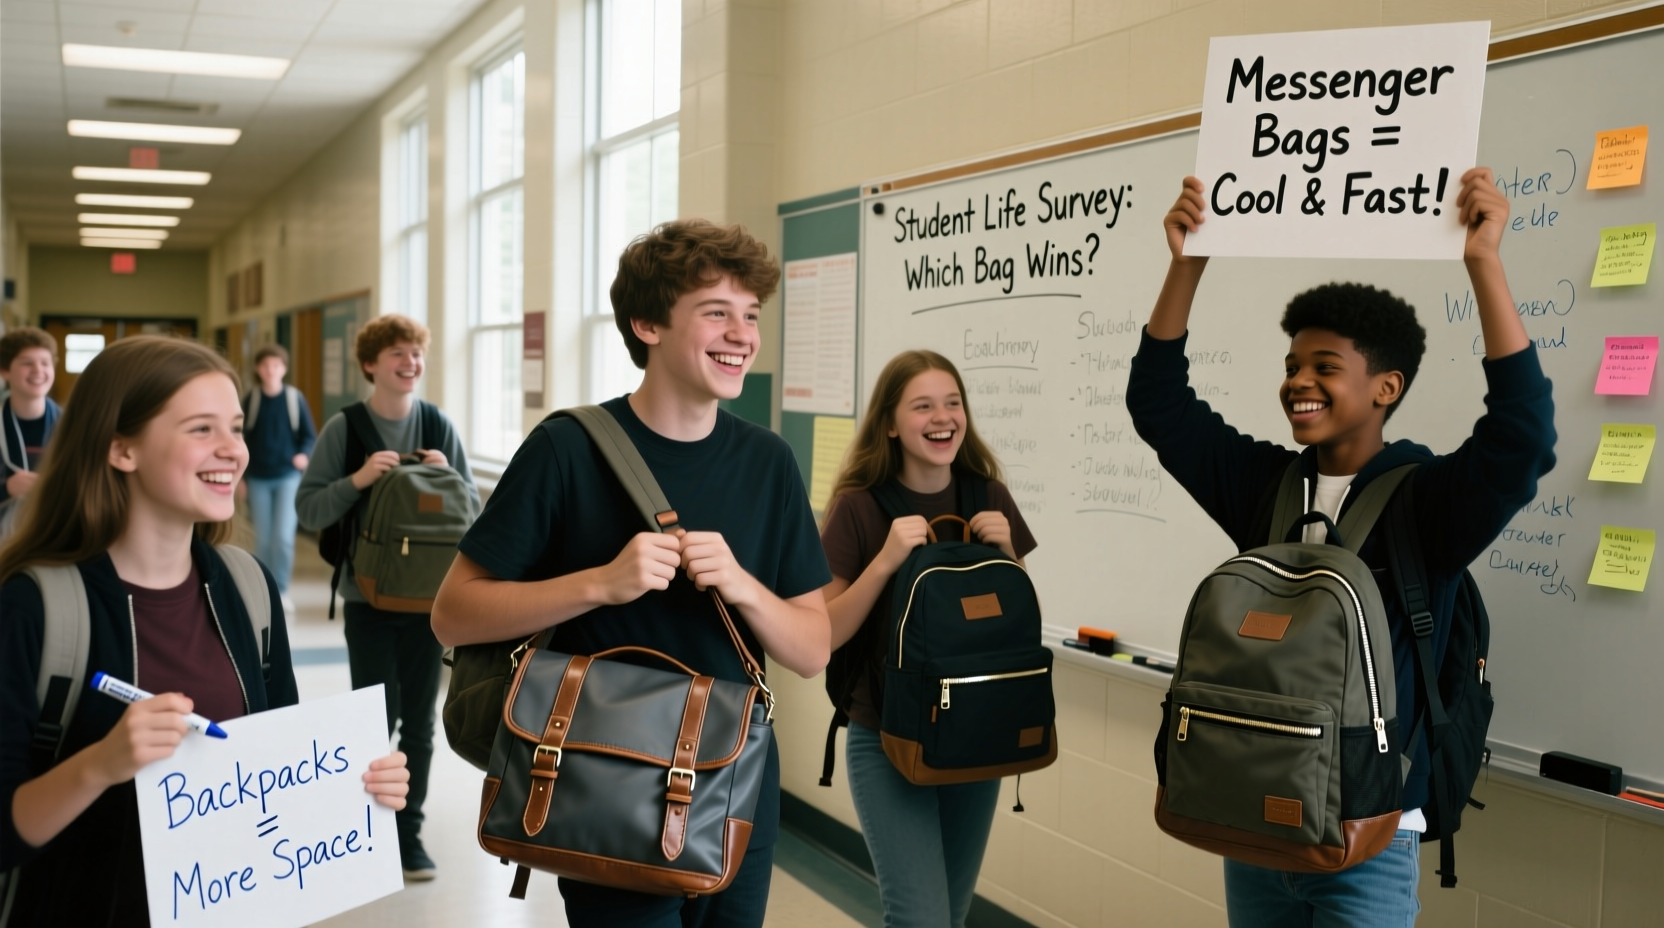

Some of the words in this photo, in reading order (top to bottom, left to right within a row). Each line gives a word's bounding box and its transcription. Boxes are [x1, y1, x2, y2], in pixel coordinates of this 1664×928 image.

[1226, 55, 1455, 116] Messenger
[1251, 112, 1351, 174] Bags
[894, 198, 976, 244] Student
[984, 188, 1026, 231] Life
[1037, 181, 1133, 230] Survey:
[1210, 171, 1287, 217] Cool
[1300, 176, 1326, 217] &
[1342, 166, 1450, 217] Fast!
[904, 251, 964, 292] Which
[974, 245, 1015, 295] Bag
[1026, 232, 1100, 279] Wins?
[158, 739, 349, 830] Backpacks
[170, 861, 257, 920] More
[273, 804, 374, 890] Space!
